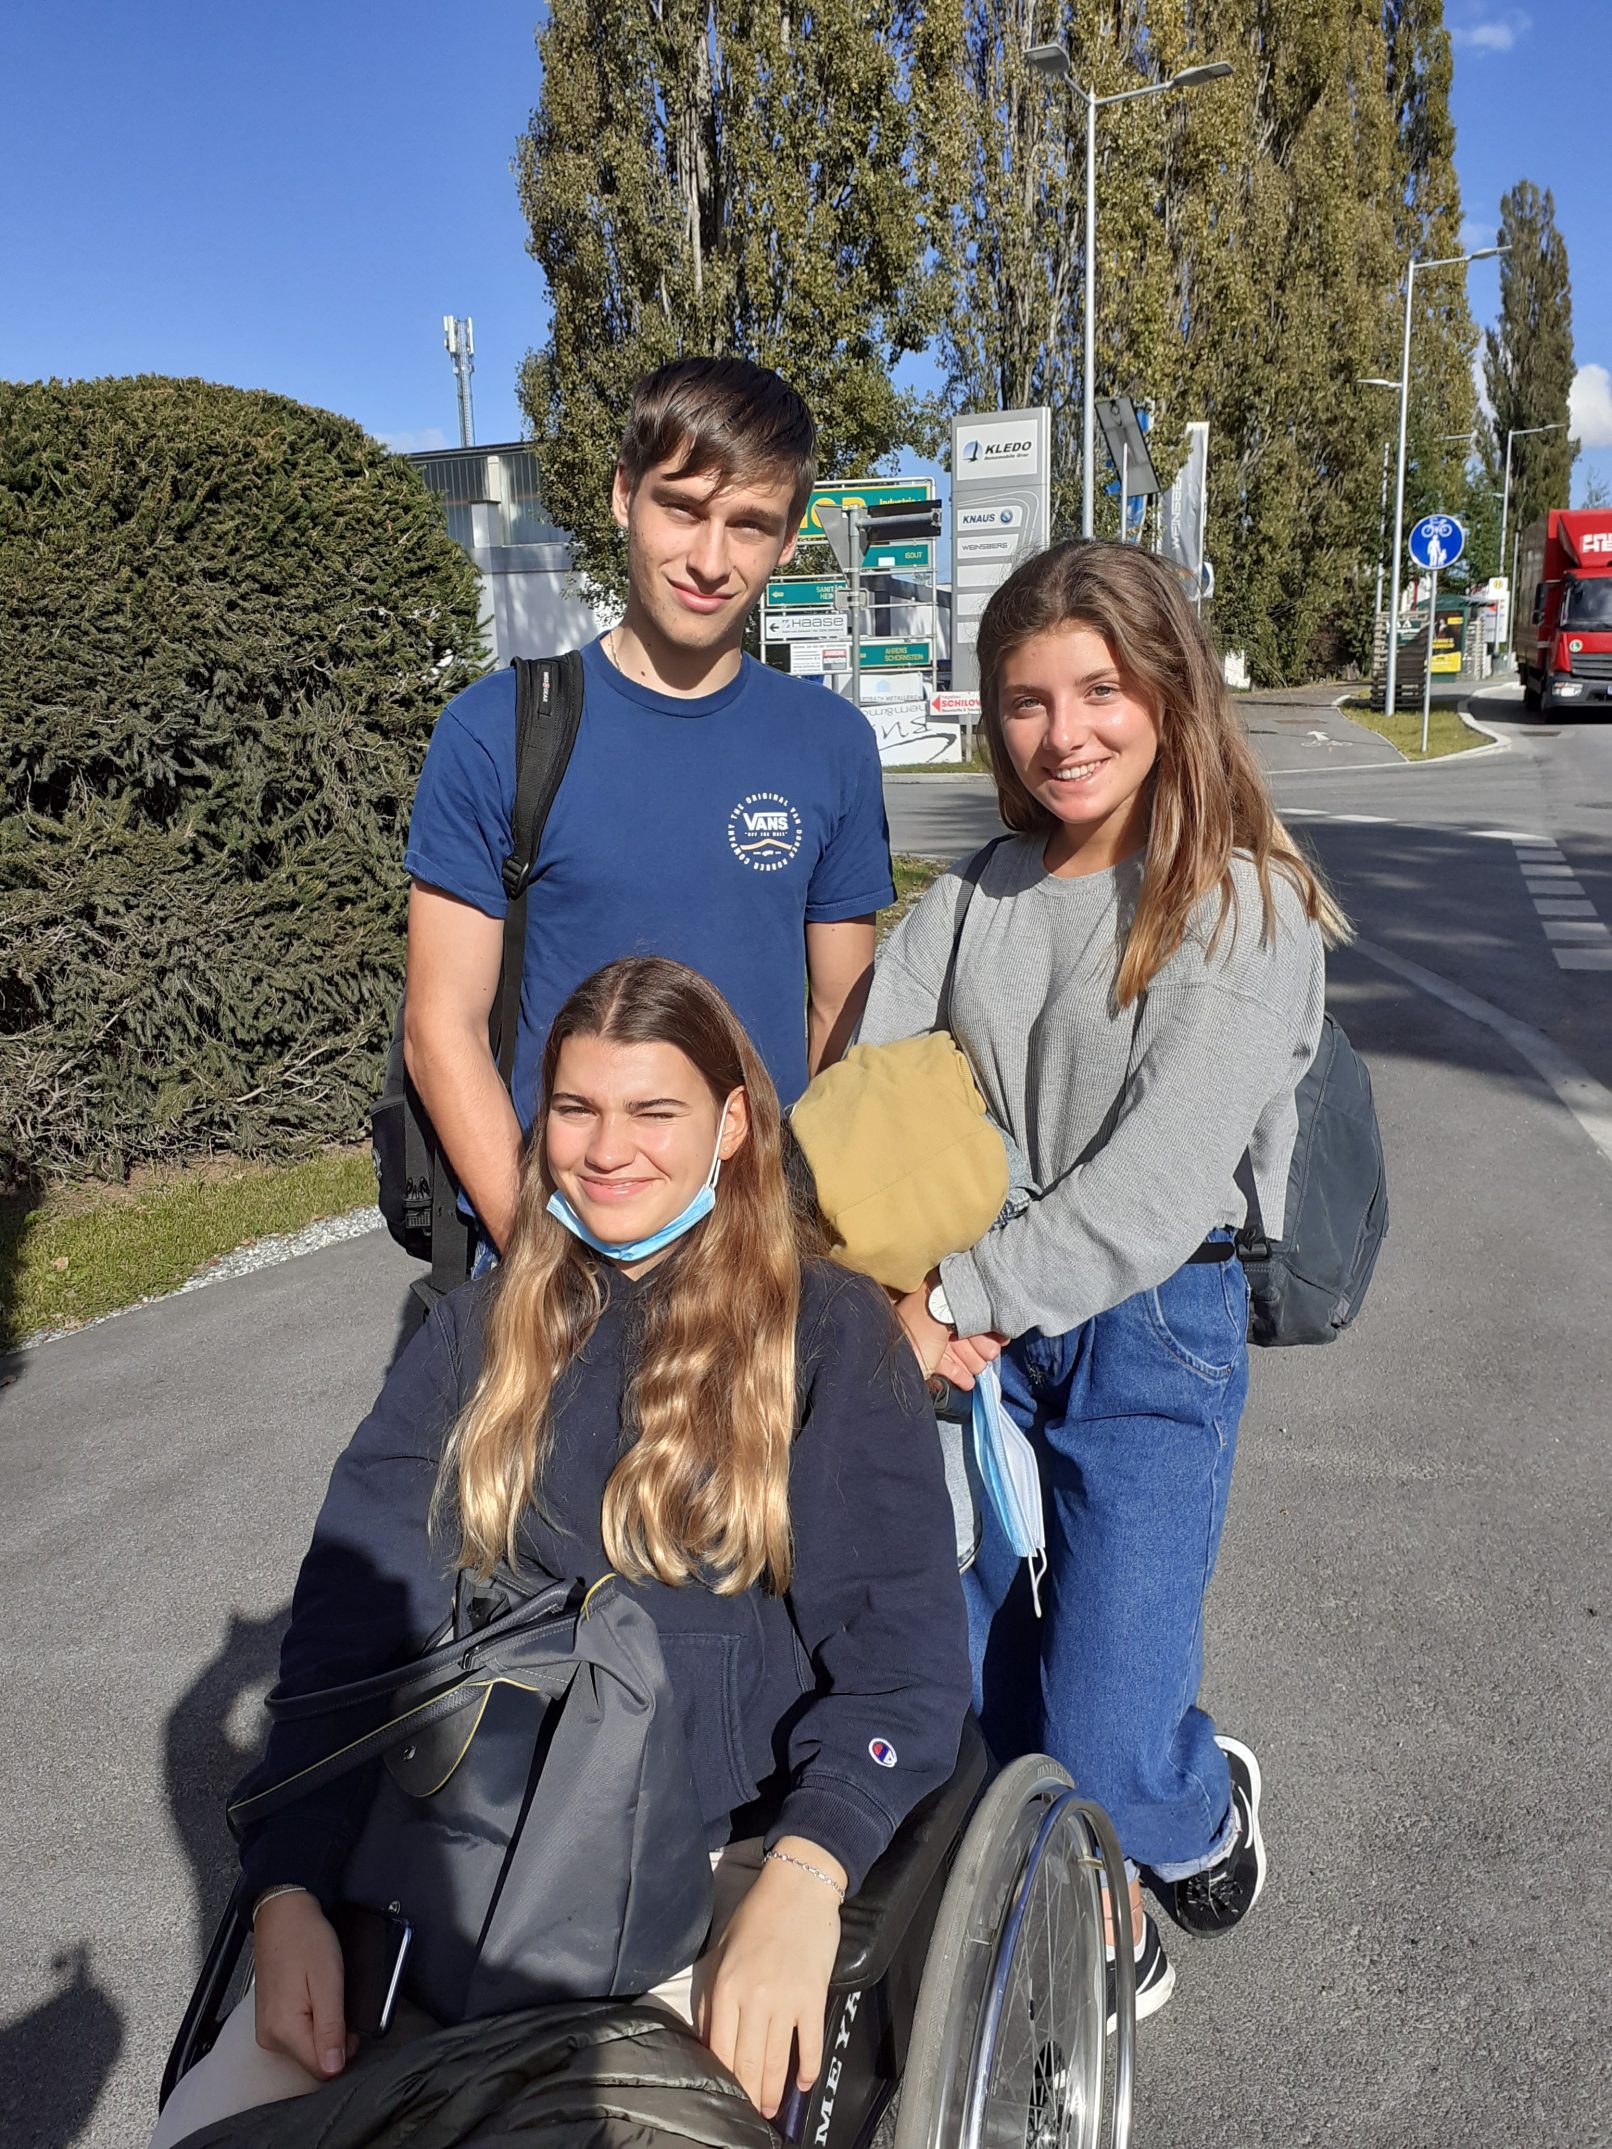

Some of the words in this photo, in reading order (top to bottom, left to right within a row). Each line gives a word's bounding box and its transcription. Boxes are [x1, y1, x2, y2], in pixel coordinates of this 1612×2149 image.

[984, 441, 1032, 455] KLEDO
[962, 513, 996, 524] KNAUS
[730, 803, 745, 820] THE
[742, 811, 789, 831] VANS
[727, 823, 750, 865] COMPANY
